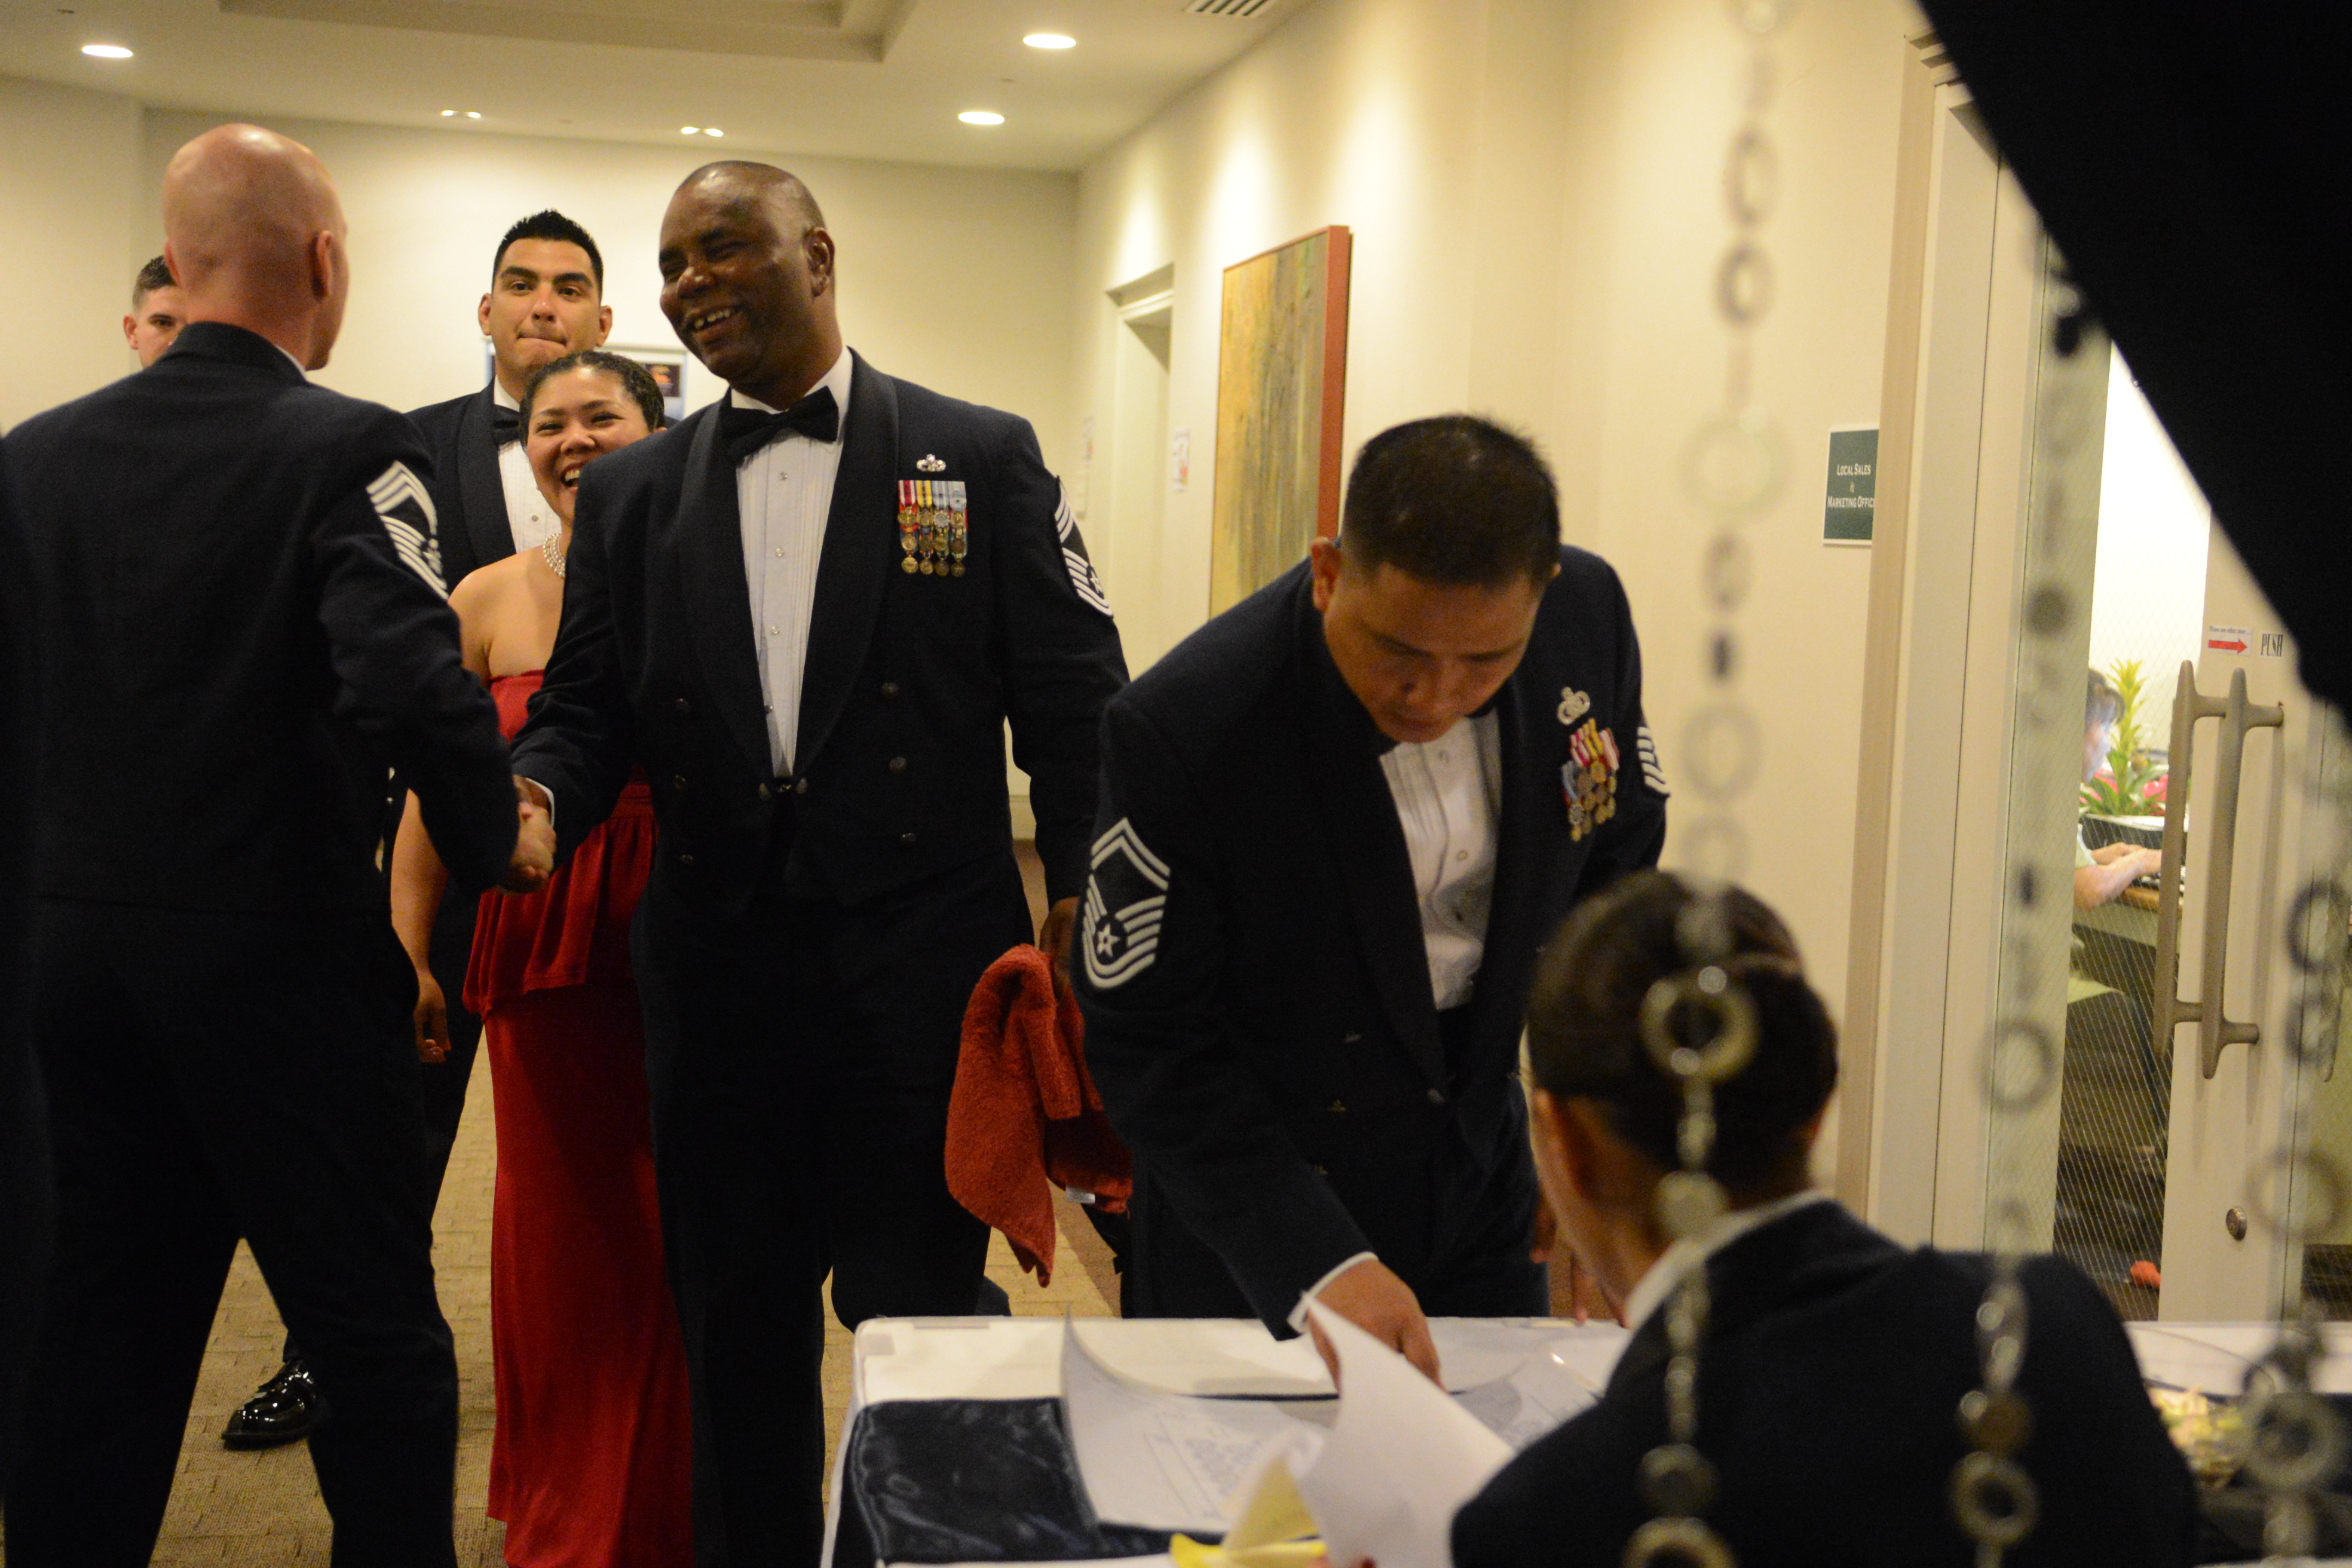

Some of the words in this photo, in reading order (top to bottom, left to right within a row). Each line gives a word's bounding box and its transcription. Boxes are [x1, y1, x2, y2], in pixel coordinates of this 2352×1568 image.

[1836, 464, 1854, 476] LOCAL
[1854, 463, 1871, 476] SALES
[1827, 495, 1857, 508] MARKETING
[1857, 495, 1874, 508] OFFIC
[2261, 633, 2283, 657] PUSH
